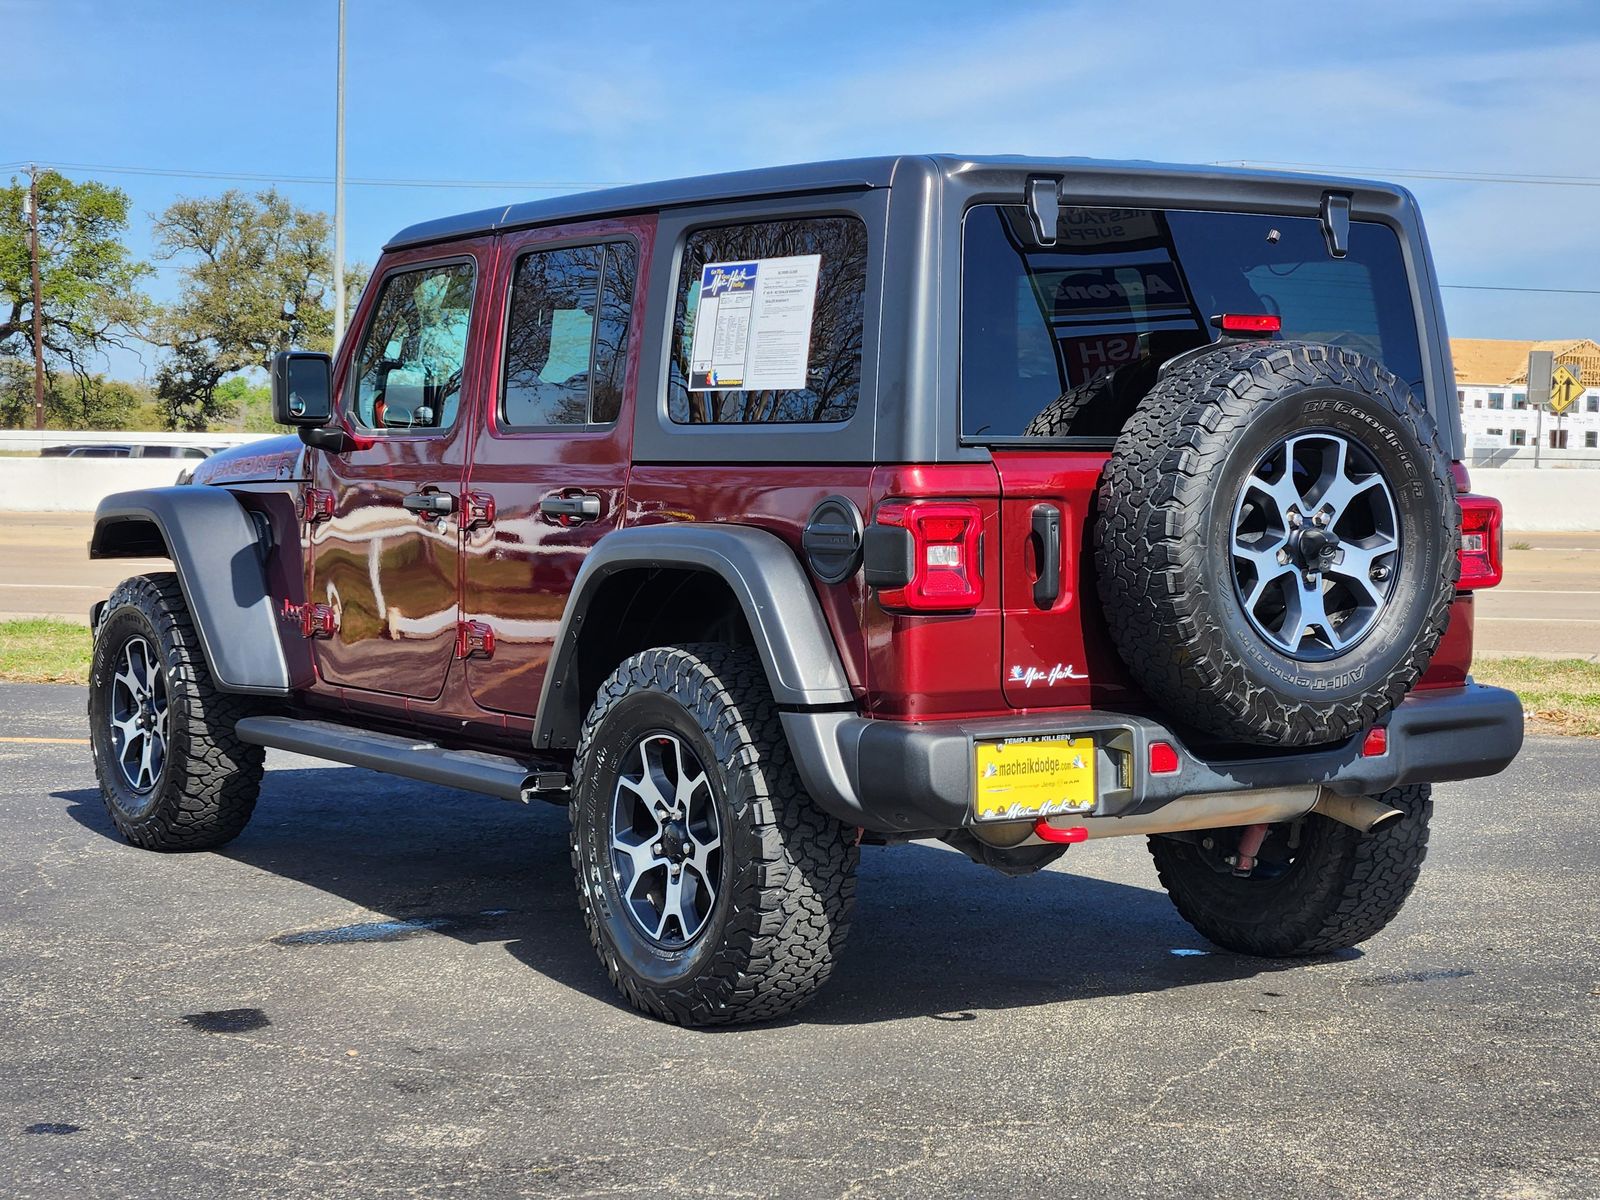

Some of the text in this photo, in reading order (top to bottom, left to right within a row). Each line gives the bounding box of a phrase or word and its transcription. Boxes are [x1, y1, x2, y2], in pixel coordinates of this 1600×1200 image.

[1303, 400, 1424, 498] BFGoodrich
[1237, 630, 1366, 691] All-Terrain
[1016, 663, 1083, 688] Mac Haik
[1004, 734, 1071, 745] TEMPLE KILLEEN
[999, 757, 1071, 776] machaikdodge.com
[996, 797, 1080, 819] Mac Haik
